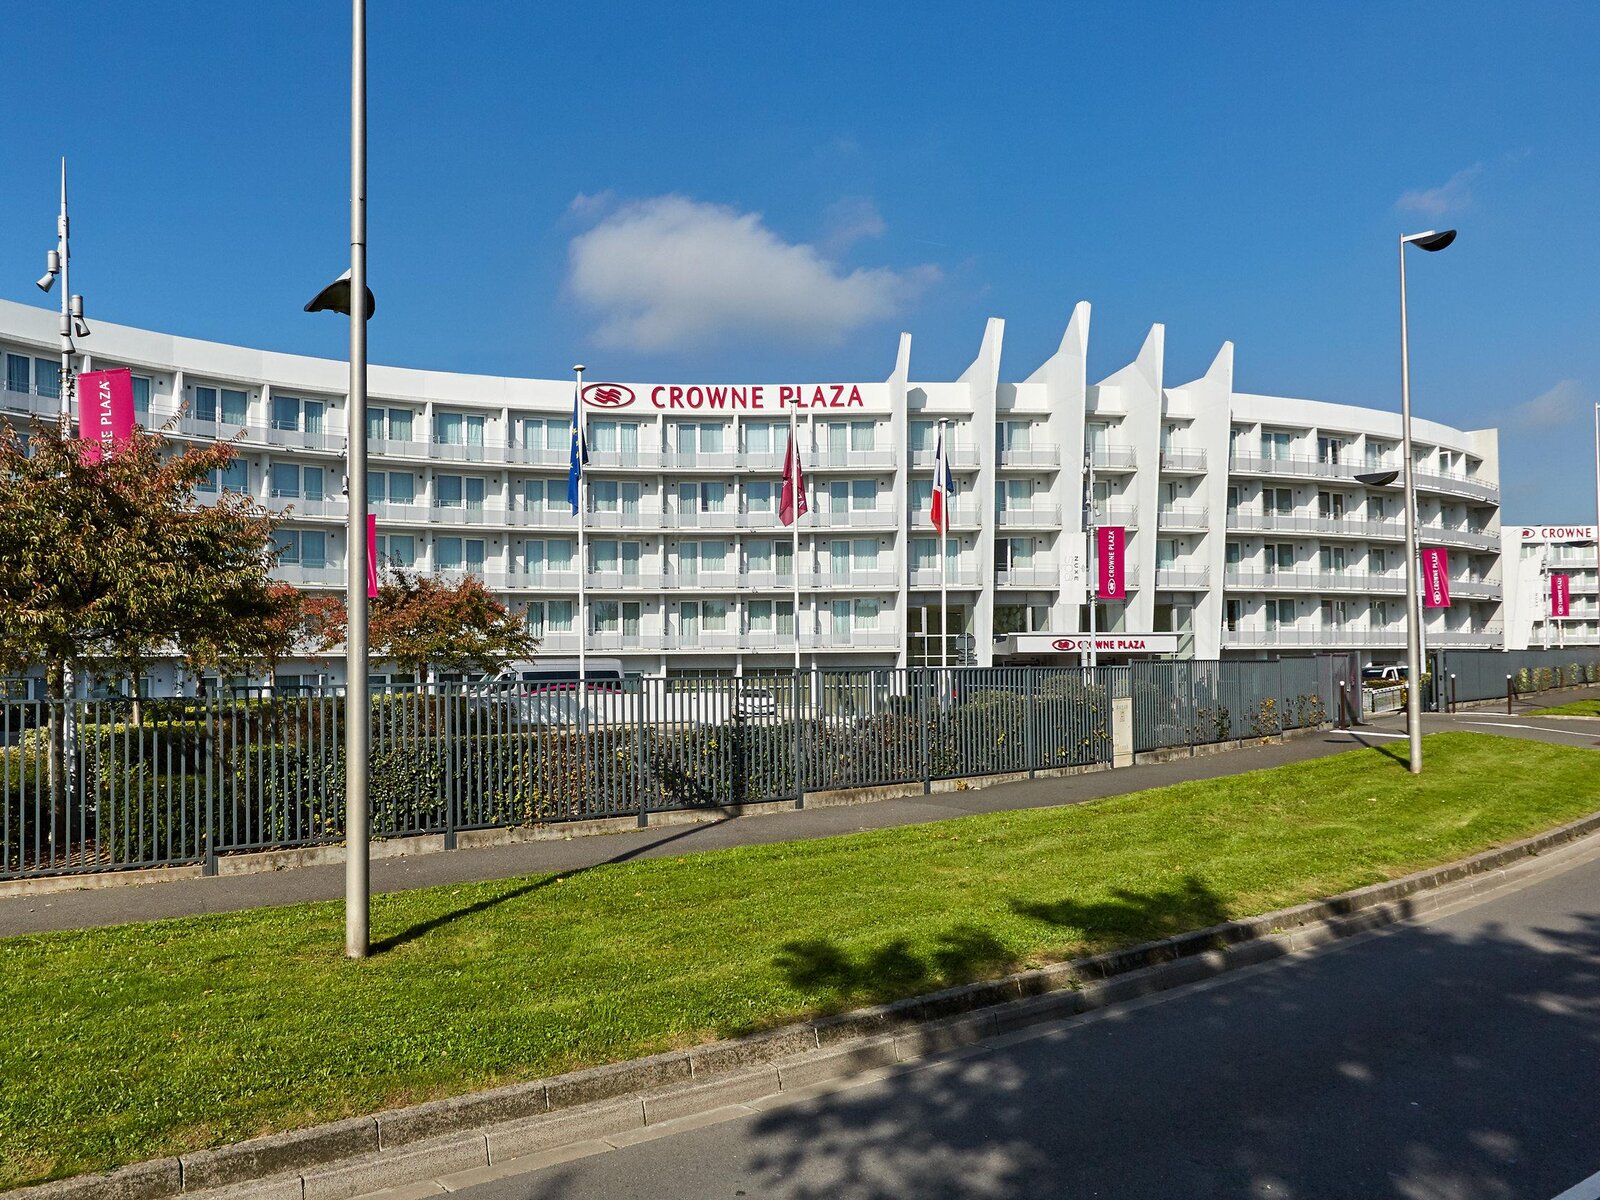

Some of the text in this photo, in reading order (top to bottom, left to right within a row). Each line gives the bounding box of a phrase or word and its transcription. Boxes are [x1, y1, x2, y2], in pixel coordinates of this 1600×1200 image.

[99, 381, 112, 425] PLAZA
[651, 385, 864, 409] CROWNE PLAZA
[1541, 527, 1591, 538] CROWNE
[1117, 640, 1145, 649] PLAZA
